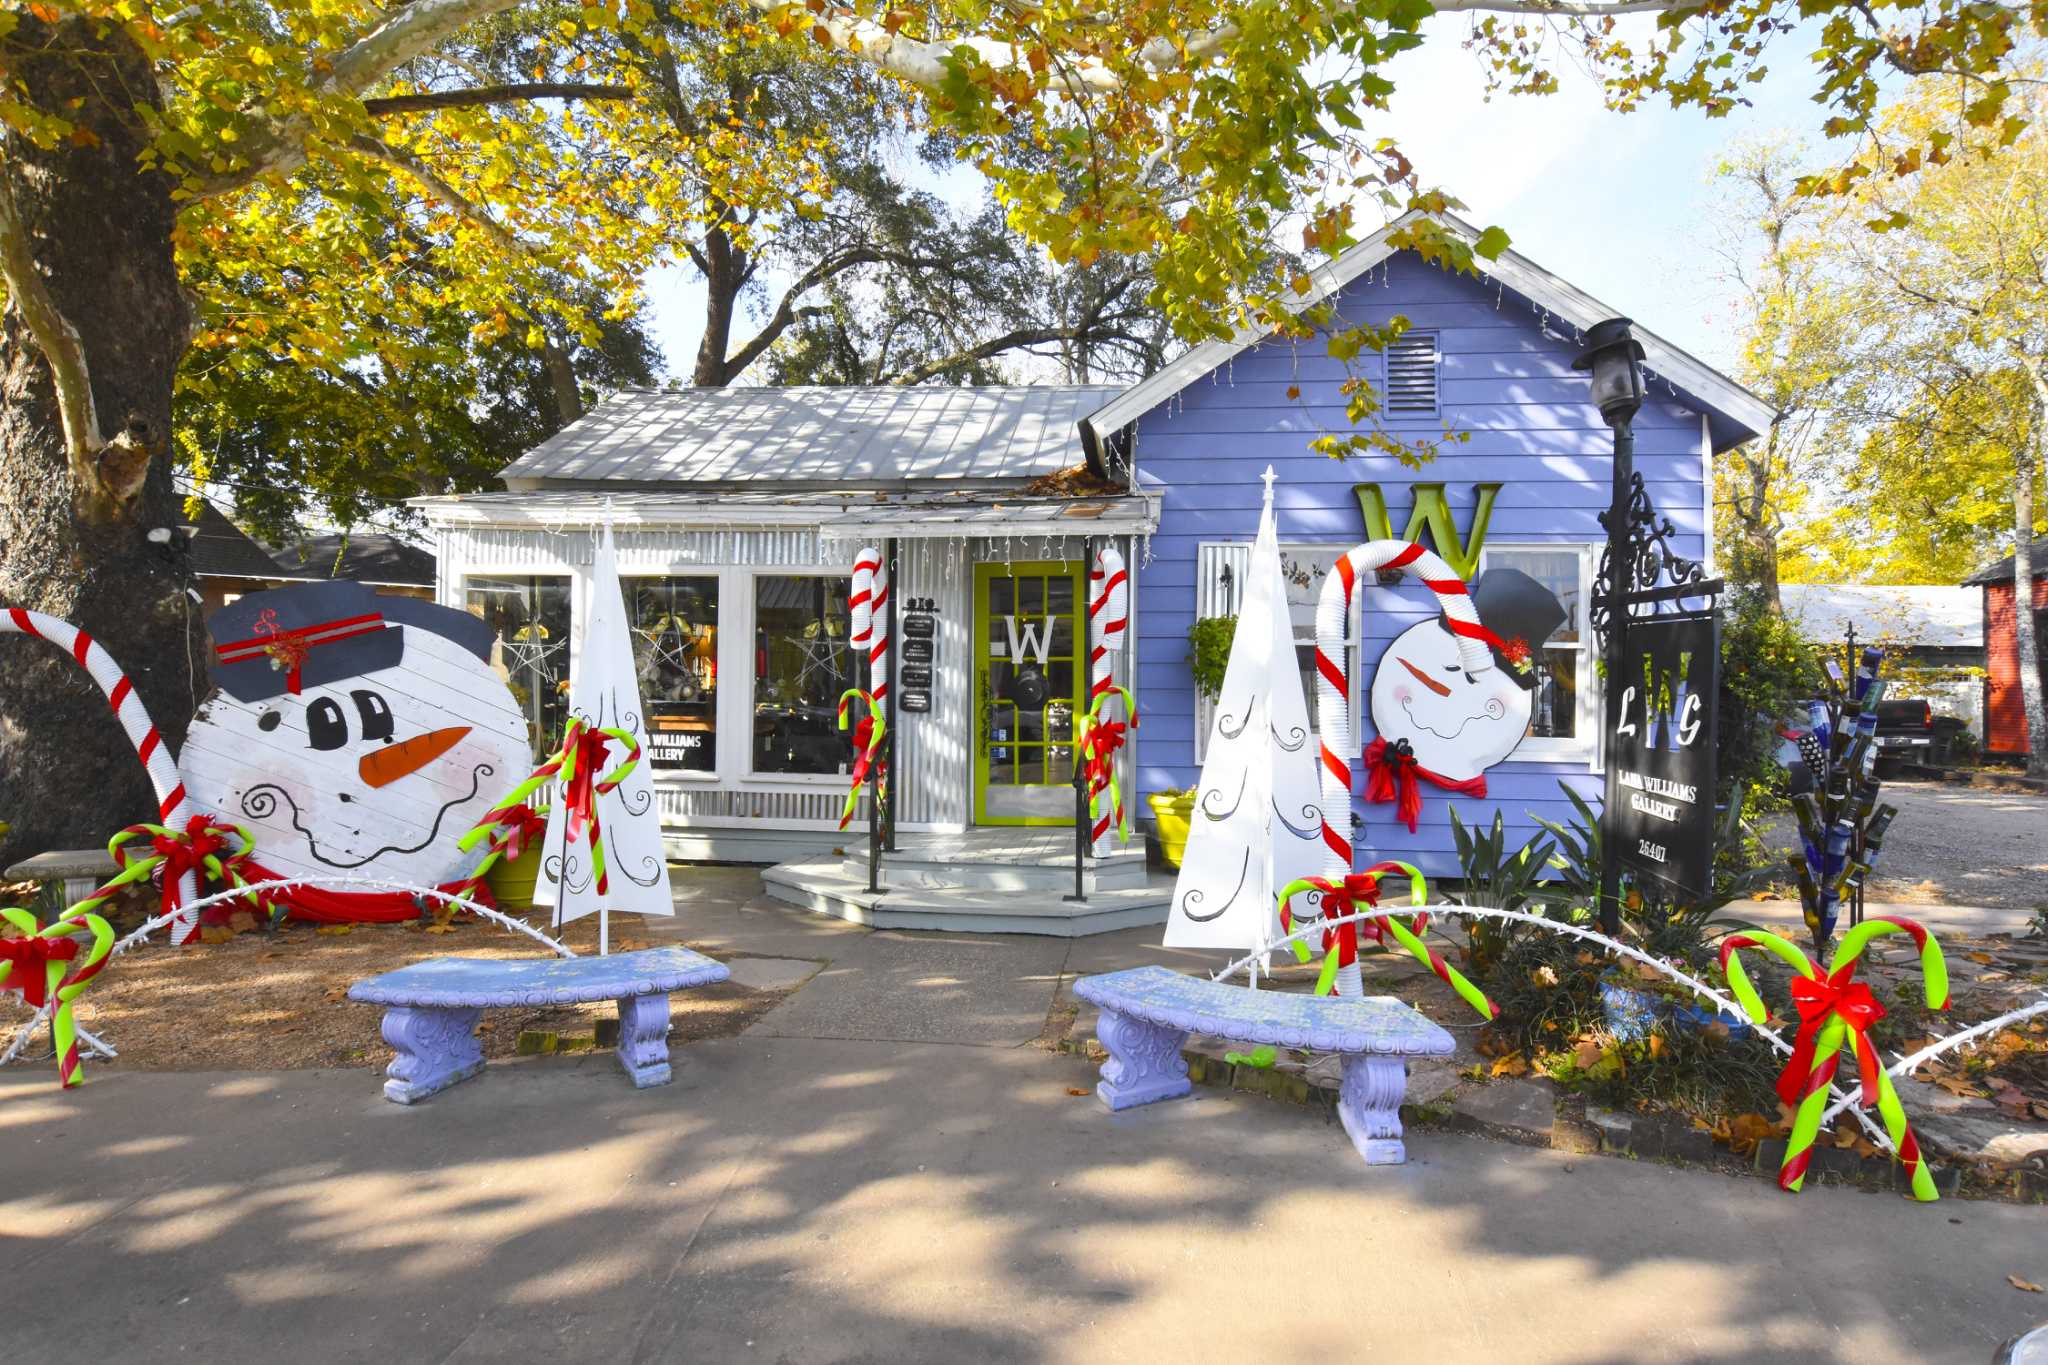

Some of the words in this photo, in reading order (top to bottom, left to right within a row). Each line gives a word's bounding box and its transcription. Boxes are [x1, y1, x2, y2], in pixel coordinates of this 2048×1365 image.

[1352, 482, 1504, 582] W
[1004, 615, 1056, 664] W
[648, 748, 685, 760] ALLERY
[652, 734, 701, 747] WILLIAMS
[1644, 776, 1697, 804] WILLIAMS
[1631, 793, 1678, 822] GALLERY
[1638, 839, 1666, 863] 26407
